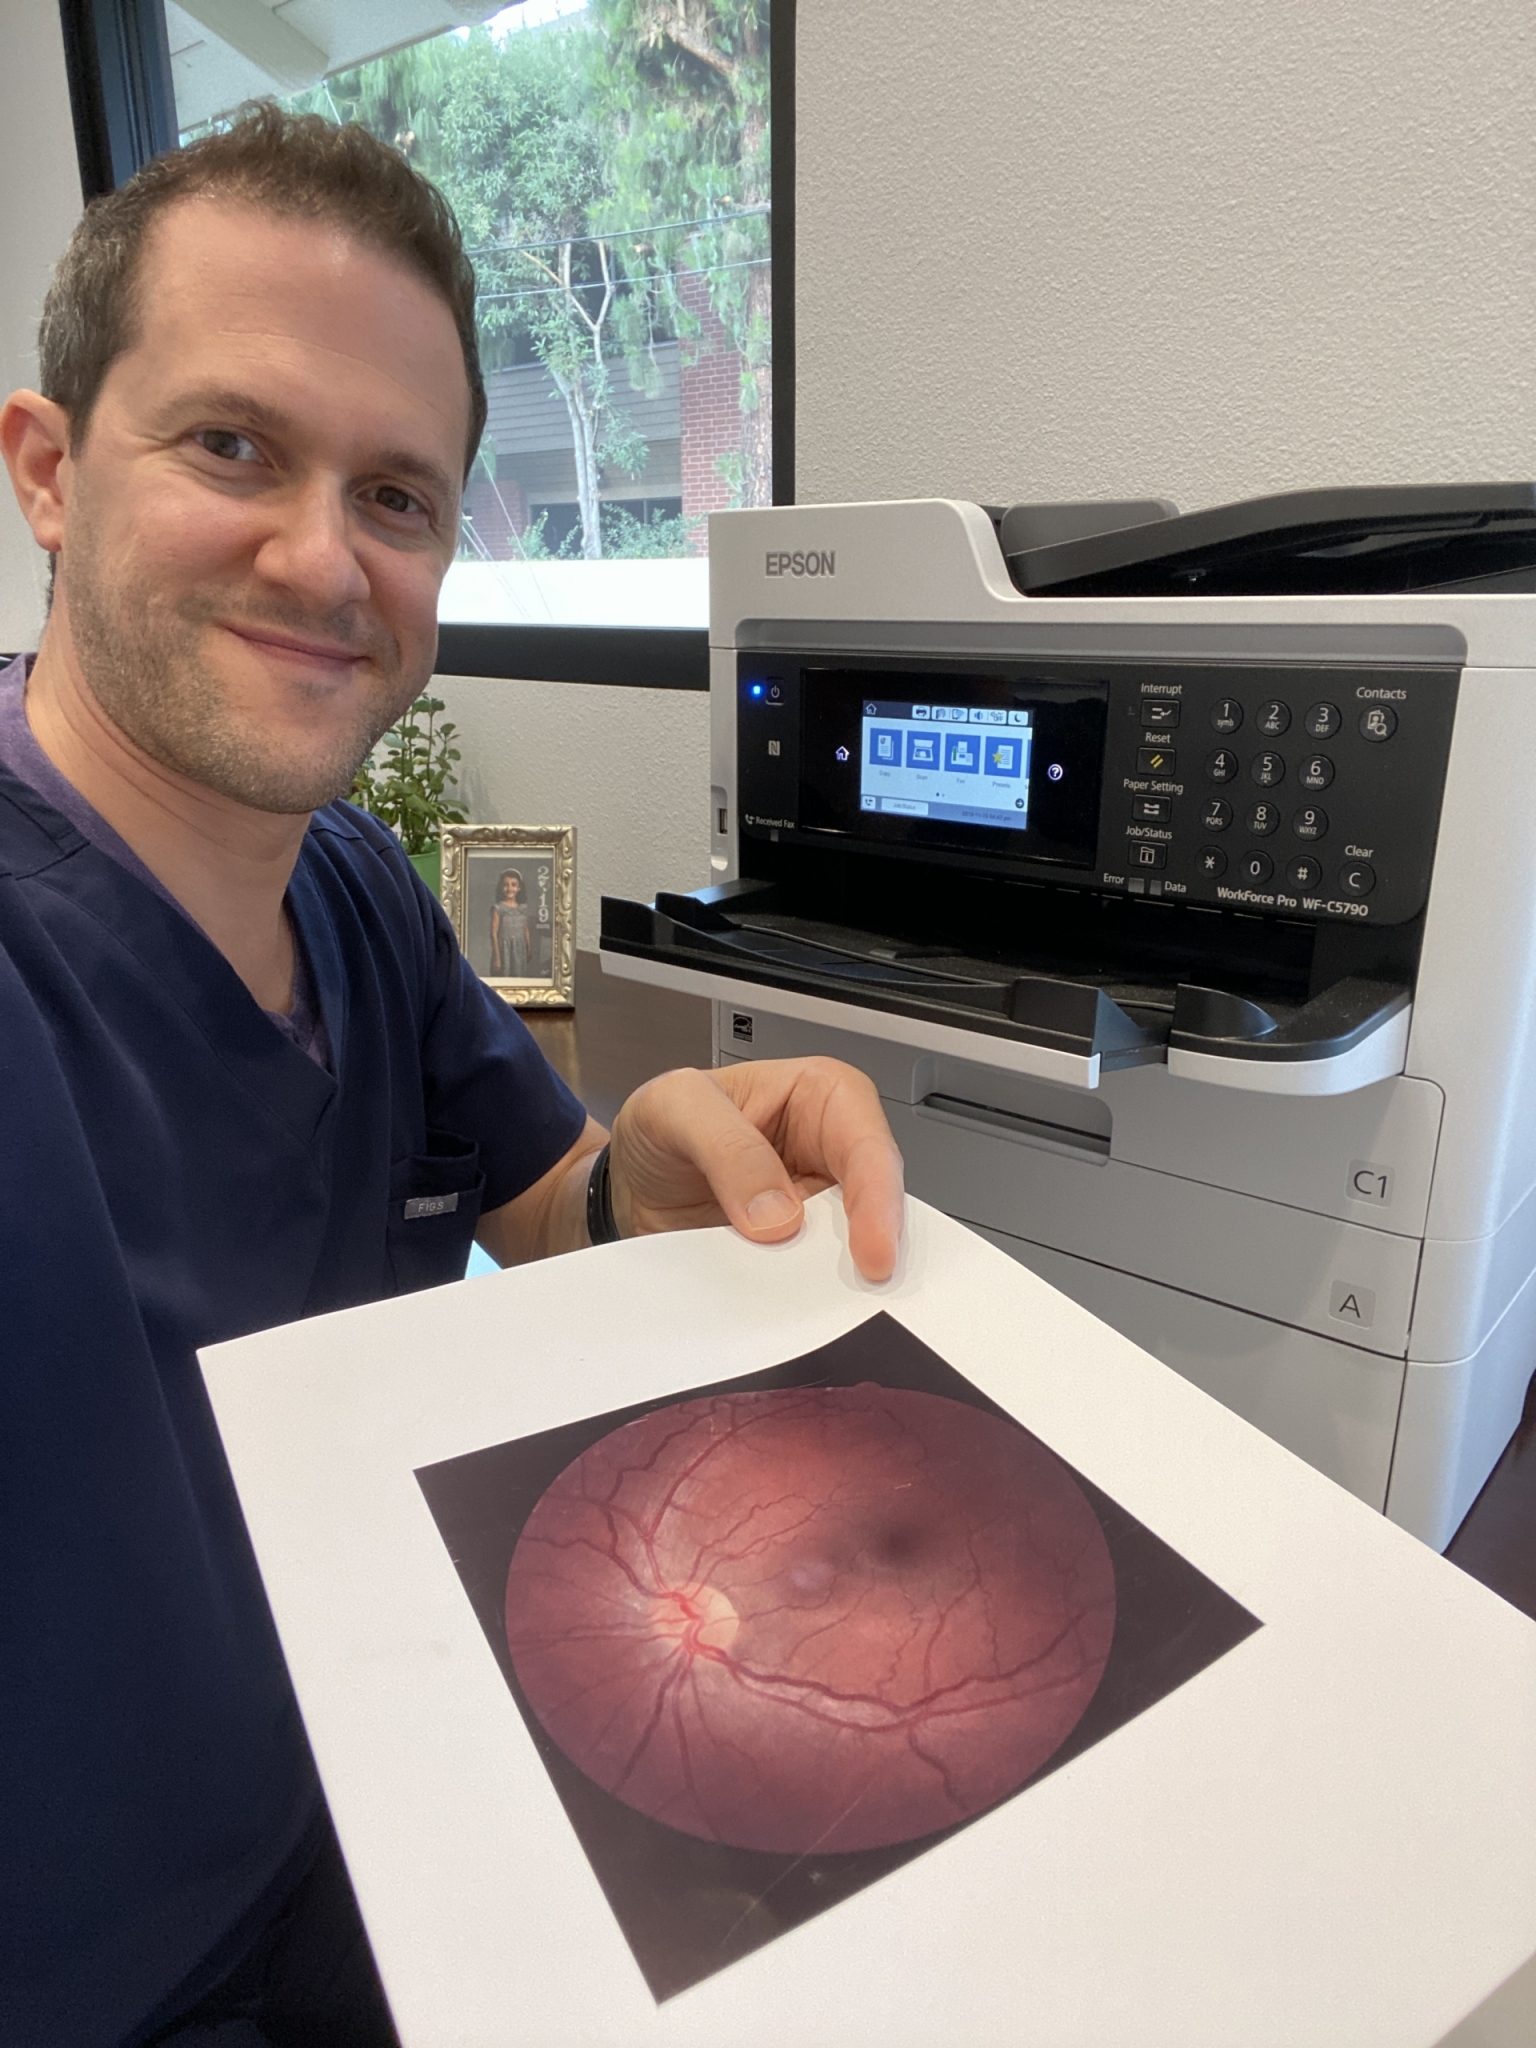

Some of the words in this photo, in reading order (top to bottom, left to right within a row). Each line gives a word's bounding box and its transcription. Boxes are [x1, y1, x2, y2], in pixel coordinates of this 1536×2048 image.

[765, 551, 835, 577] EPSON
[1141, 683, 1182, 696] Interrupt
[1356, 687, 1407, 700] Contacts
[1222, 703, 1230, 717] 1
[1268, 705, 1279, 720] 2
[1318, 707, 1329, 722] 3
[1216, 718, 1234, 728] symb
[1265, 721, 1280, 731] ABC
[1315, 723, 1330, 733] DEF
[1145, 731, 1171, 743] Reset
[1215, 753, 1225, 767] 4
[1262, 757, 1273, 771] 5
[1213, 768, 1226, 777] GHI
[1310, 760, 1321, 775] 6
[1260, 771, 1272, 781] JKL
[1306, 775, 1324, 785] MNO
[1123, 779, 1149, 791] Paper
[1151, 781, 1184, 794] Setting
[1211, 802, 1221, 816] 7
[1256, 806, 1267, 821] 8
[756, 815, 782, 827] Received
[784, 819, 795, 829] Fax
[1205, 816, 1223, 825] PQRS
[1304, 810, 1316, 825] 9
[1126, 825, 1173, 839] Job/Status
[1253, 820, 1267, 830] TUV
[1299, 825, 1318, 835] WXYZ
[1345, 845, 1374, 858] Clear
[1250, 861, 1261, 875] 0
[1103, 873, 1125, 885] Error
[1348, 872, 1361, 888] C
[1164, 881, 1187, 893] Data
[1217, 887, 1274, 905] WorkForce
[1277, 895, 1297, 908] Pro
[1302, 897, 1369, 917] WF-C5790
[1353, 1170, 1387, 1199] C1
[418, 1200, 444, 1213] FIGS
[1338, 1293, 1361, 1319] A
